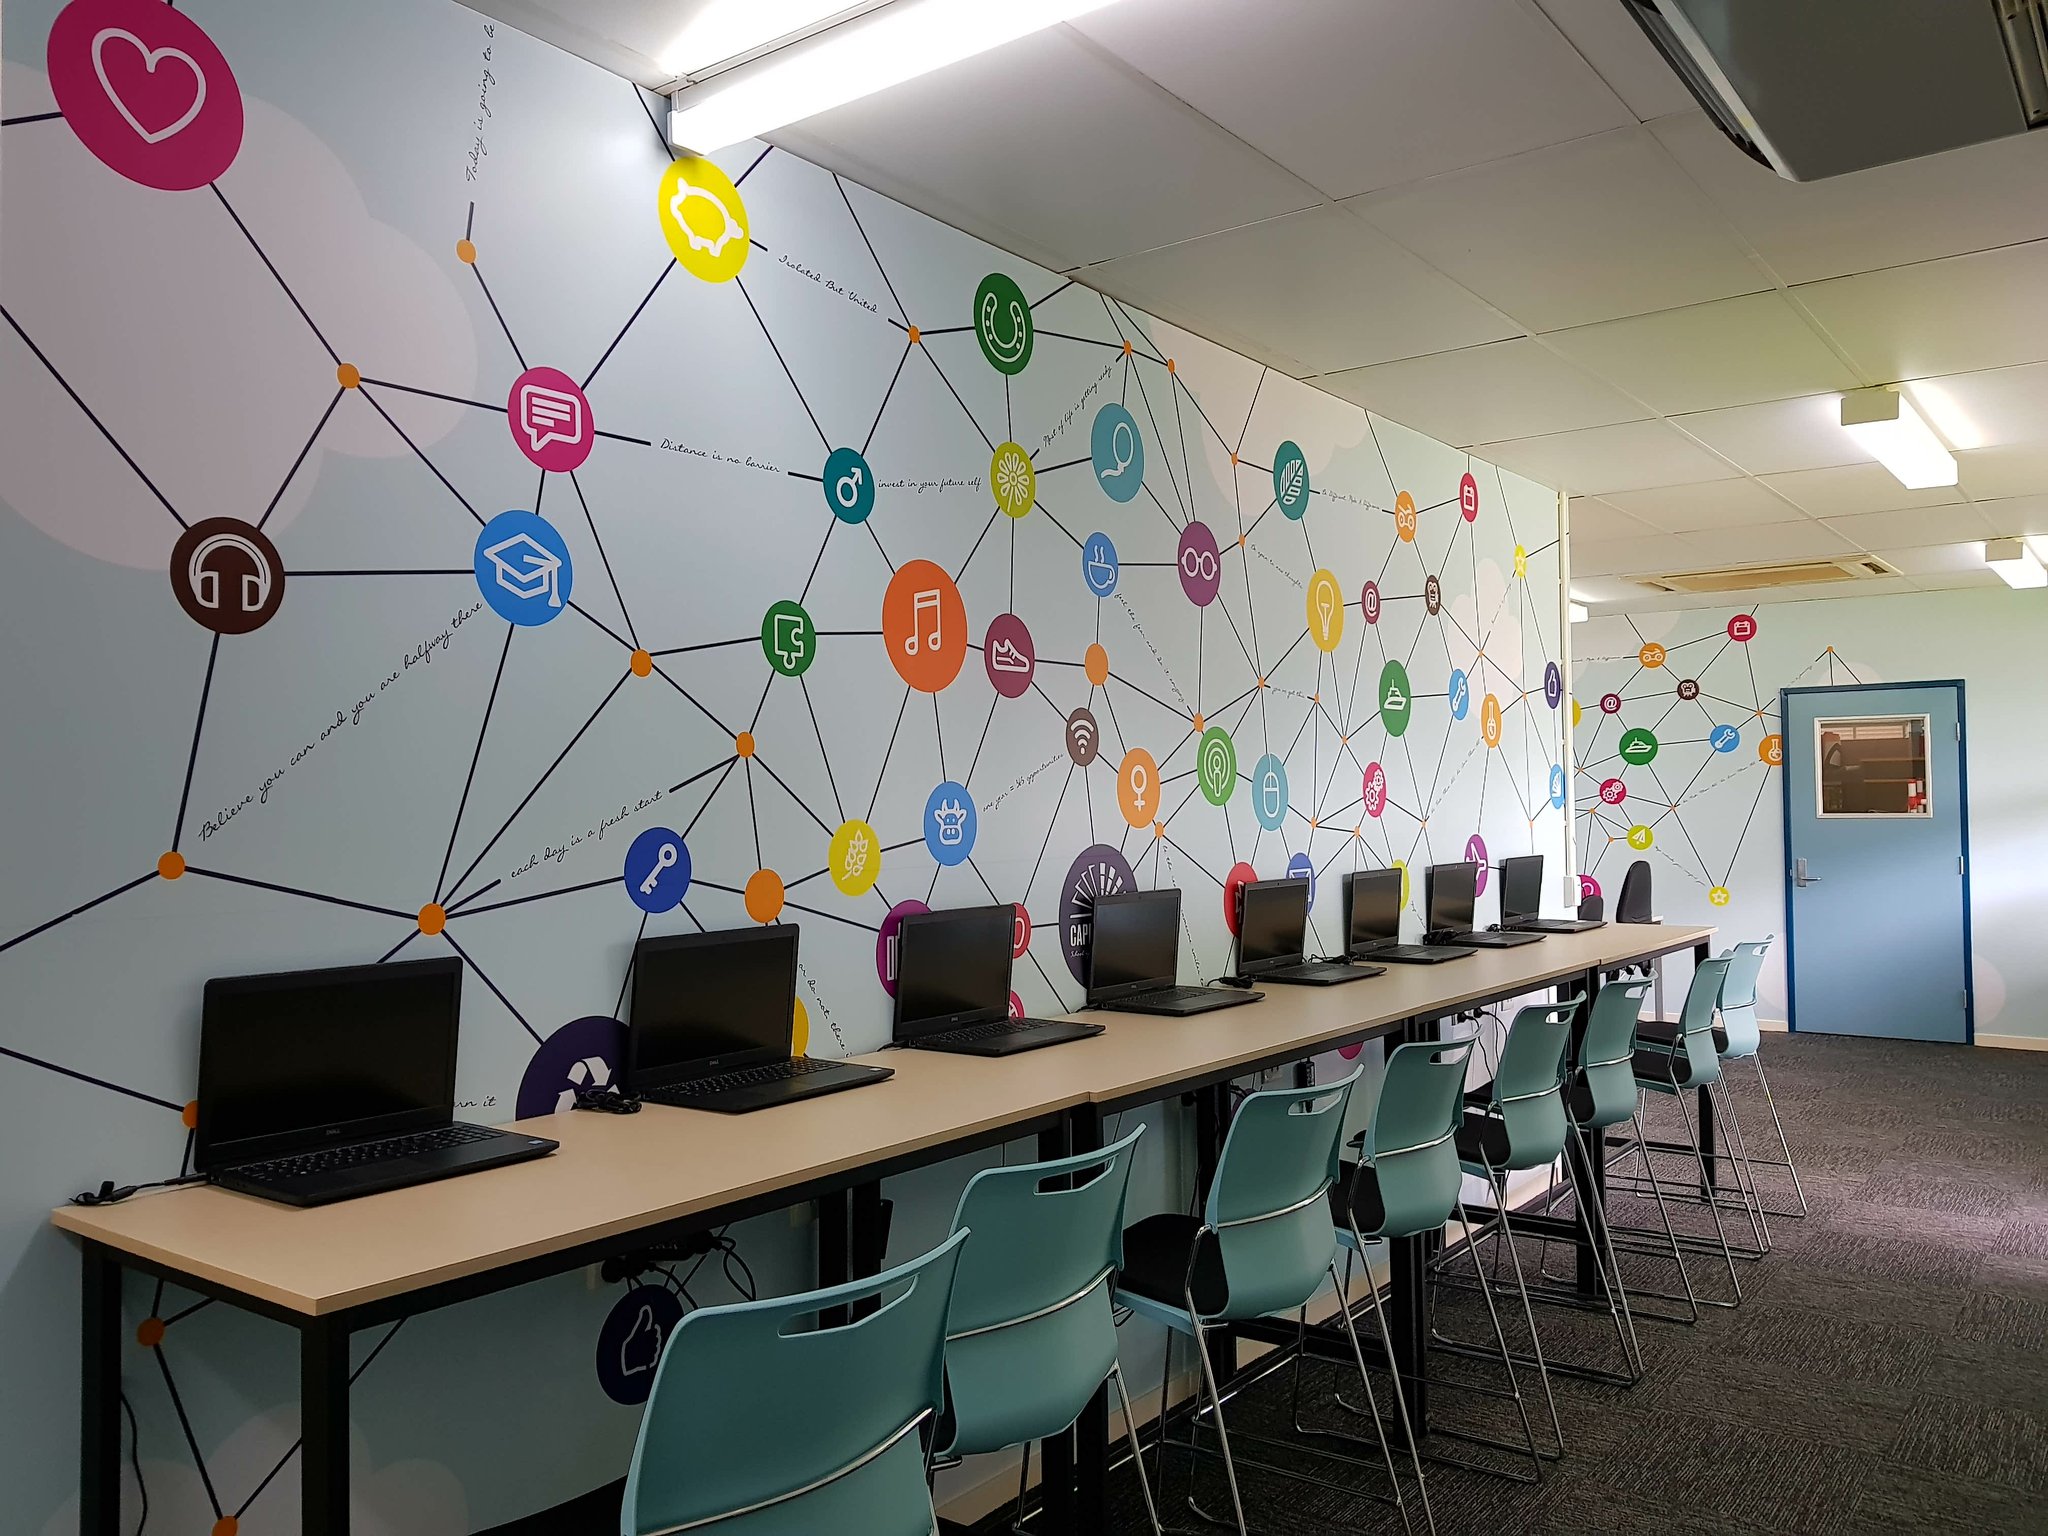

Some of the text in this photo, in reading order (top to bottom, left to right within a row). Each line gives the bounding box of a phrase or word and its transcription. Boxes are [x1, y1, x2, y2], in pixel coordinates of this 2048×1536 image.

[466, 23, 496, 182] Today is going to be
[778, 254, 878, 314] Isolated But United
[660, 438, 780, 473] Distance is no barrier
[878, 477, 982, 494] invest in your future self
[198, 601, 483, 841] Believe you can and you are halfway there
[511, 790, 663, 879] each day is a fresh start
[483, 1095, 497, 1107] it
